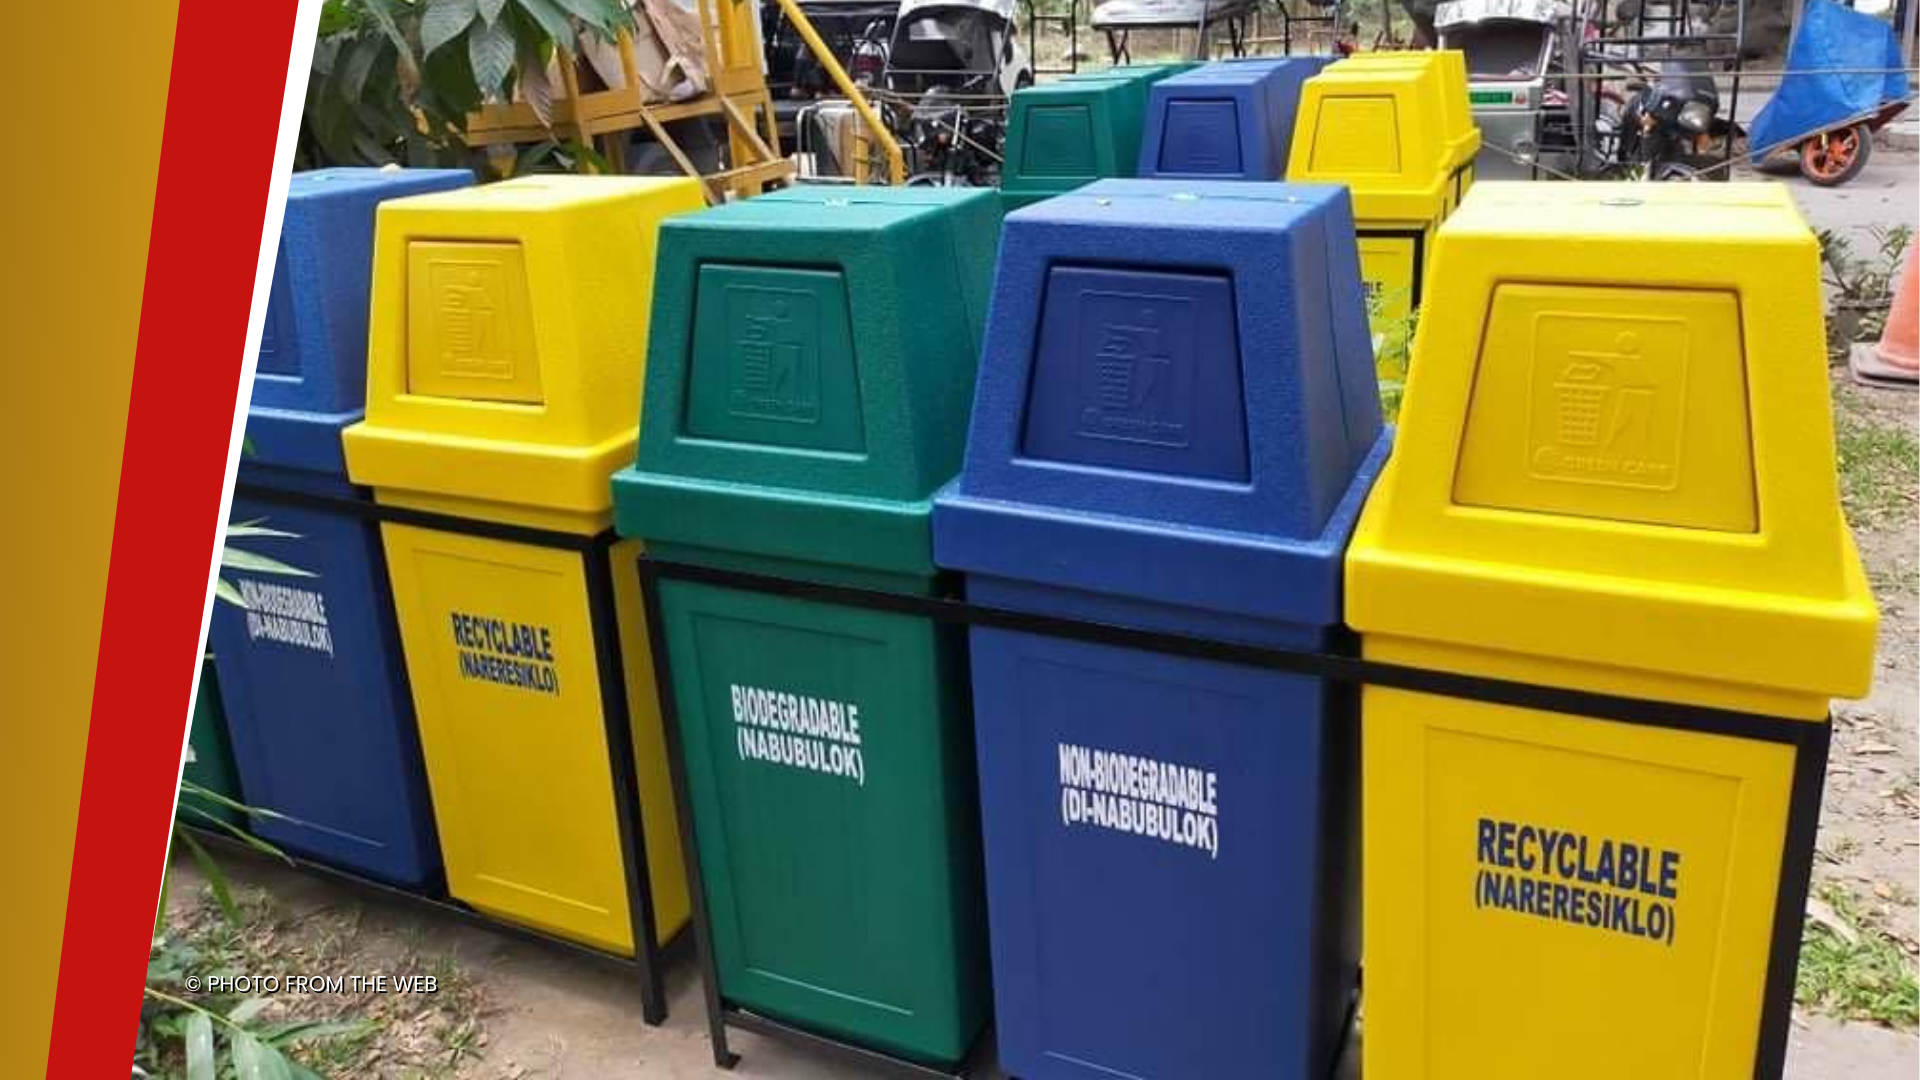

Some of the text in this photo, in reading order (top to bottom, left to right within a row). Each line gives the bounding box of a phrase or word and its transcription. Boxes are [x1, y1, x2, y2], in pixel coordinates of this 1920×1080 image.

[451, 611, 554, 662] RECYCLABLE
[459, 649, 560, 698] (NARERESIKLO)
[731, 684, 861, 745] BIODEGRADABLE
[737, 725, 865, 788] (NABUBULOK)
[1058, 742, 1218, 816] NON-BIODEGRADABLE
[1062, 786, 1219, 860] (DI-NABUBULOK)
[1477, 818, 1680, 899] RECYCLABLE
[1475, 869, 1675, 947] (NARERESIKLO)
